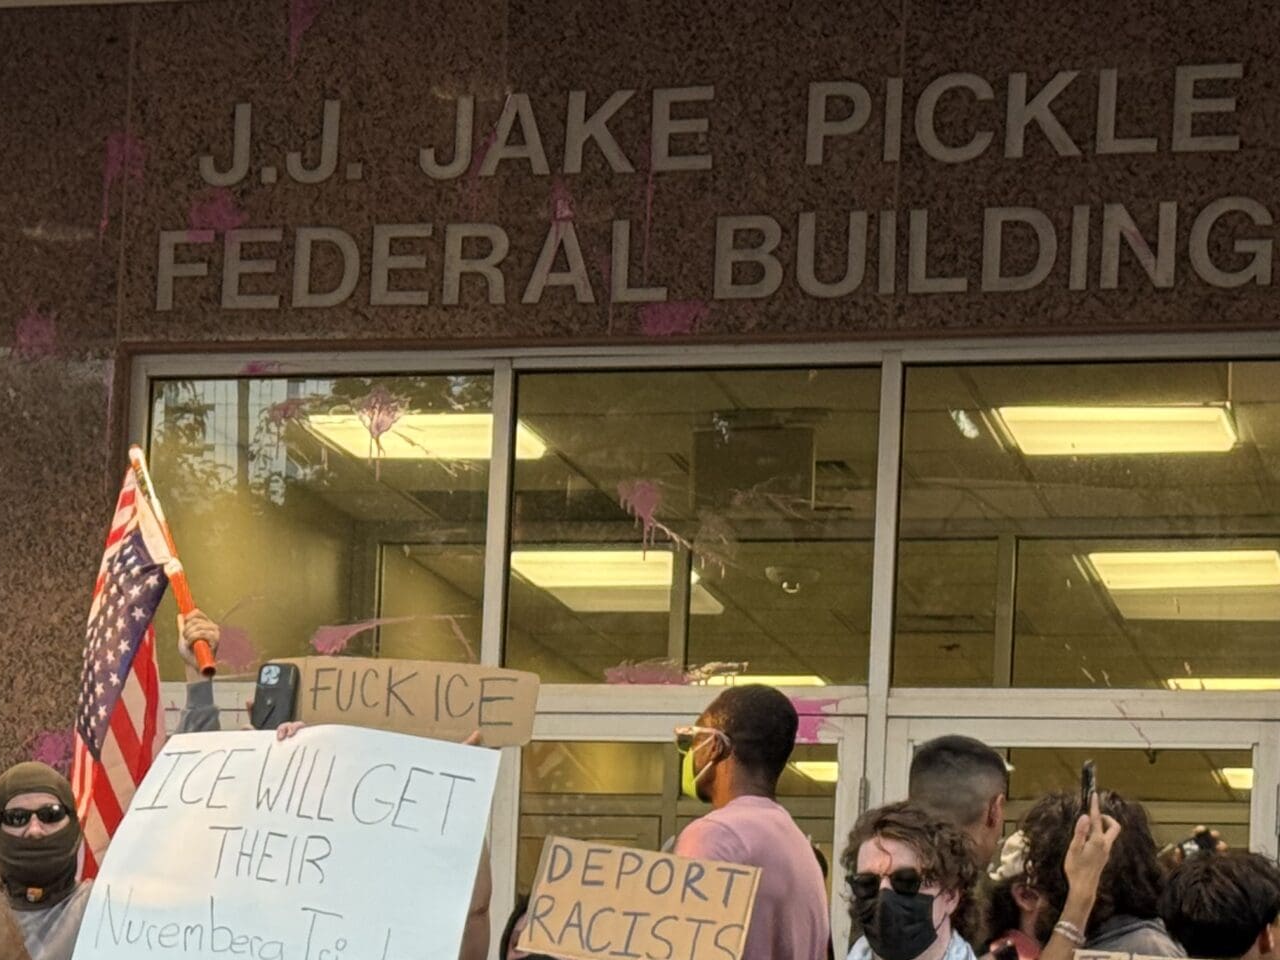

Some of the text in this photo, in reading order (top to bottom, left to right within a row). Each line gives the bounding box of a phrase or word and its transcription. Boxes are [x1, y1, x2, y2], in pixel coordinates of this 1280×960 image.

[199, 62, 1245, 187] J.J. JAKE PICKLE
[156, 196, 1276, 312] FEDERAL BUILDING
[308, 666, 520, 727] FUCK ICE
[134, 744, 477, 836] ICE WILL GET
[208, 825, 333, 886] THEIR
[546, 843, 751, 908] DEPORT
